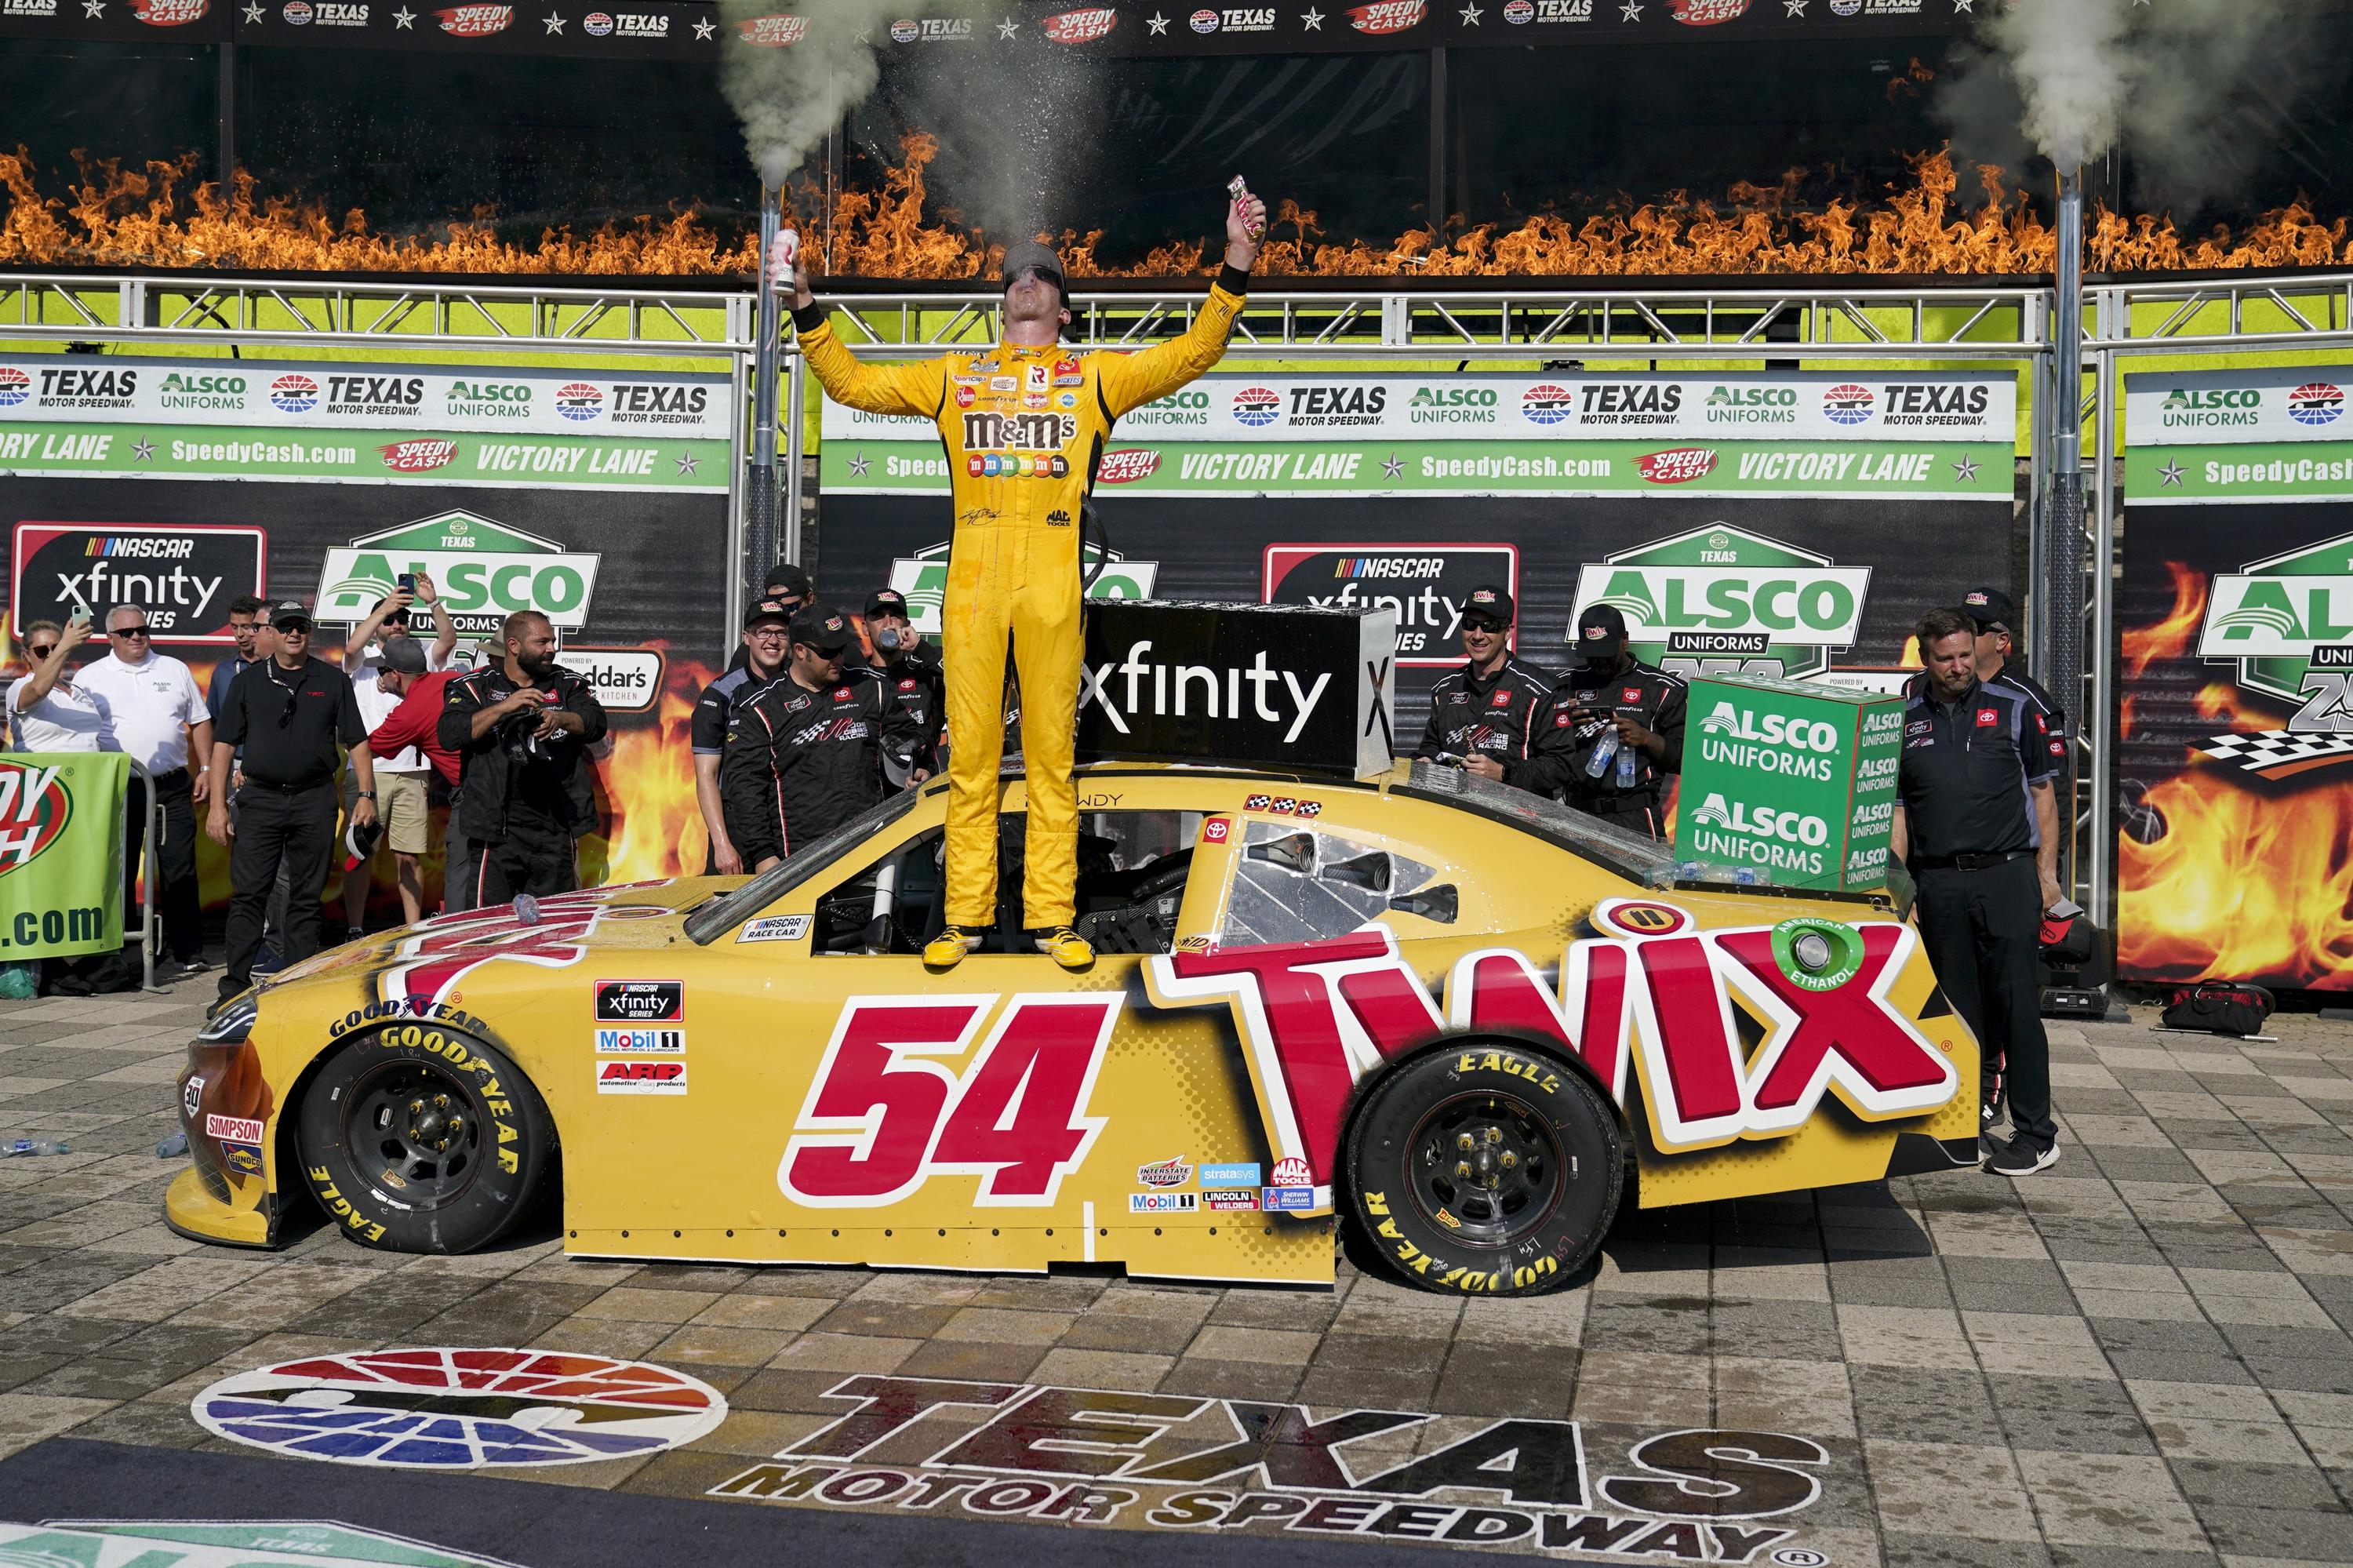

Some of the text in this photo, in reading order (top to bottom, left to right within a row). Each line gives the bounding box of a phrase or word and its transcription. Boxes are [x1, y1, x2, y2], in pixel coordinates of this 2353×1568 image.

[315, 3, 369, 21] TEXAS
[455, 3, 512, 22] SPEEDY
[1060, 8, 1115, 29] SPEEDY
[1221, 9, 1275, 27] TEXAS
[1367, 0, 1424, 20] SPEEDY
[1537, 0, 1592, 17] TEXAS
[616, 14, 669, 32] TEXAS
[922, 18, 973, 35] TEXAS
[40, 370, 137, 397] TEXAS
[159, 373, 246, 394] ALSCO
[328, 377, 424, 405] TEXAS
[445, 381, 532, 402] ALSCO
[39, 398, 135, 409] MOTOR SPEEDWAY
[161, 396, 245, 409] UNIFORMS
[612, 386, 707, 413] TEXAS
[1289, 387, 1387, 414] TEXAS
[1408, 387, 1497, 407] ALSCO
[1582, 384, 1682, 413] TEXAS
[1704, 386, 1797, 406] ALSCO
[1884, 384, 1989, 413] TEXAS
[2160, 388, 2260, 409] ALSCO
[327, 404, 422, 417] MOTOR SPEEDWAY
[448, 403, 530, 418] UNIFORMS
[612, 413, 705, 424] MOTOR SPEEDWAY
[1126, 412, 1208, 425] UNIFORMS
[1411, 409, 1496, 424] UNIFORMS
[1580, 414, 1679, 425] MOTOR SPEEDWAY
[1707, 409, 1795, 423] UNIFORMS
[1883, 415, 1987, 426] MOTOR SPEEDWAY
[2163, 412, 2258, 427] UNIFORMS
[1289, 416, 1385, 426] MOTOR SPEEDWAY
[42, 434, 113, 460] LANE
[172, 439, 356, 464] SpeedyCash.com
[397, 441, 456, 457] SPEEDY
[477, 444, 658, 475] VICTORY LANE
[1104, 450, 1159, 469] SPEEDY
[1180, 453, 1363, 480] VICTORY LANE
[1421, 456, 1610, 478] SpeedyCash.com
[1654, 449, 1717, 468] SPEEDY
[1738, 453, 1934, 481] VICTORY LANE
[1046, 509, 1071, 522] MAC
[111, 537, 194, 558] NASCAR
[441, 536, 475, 548] TEXAS
[1700, 550, 1737, 562] TEXAS
[1361, 558, 1444, 578] NASCAR
[56, 561, 223, 618] xfinity
[1581, 570, 1854, 631] ALSCO
[416, 613, 500, 631] UNORMS
[1675, 635, 1763, 651] UNIFORMS
[601, 690, 638, 700] KITCHEN
[1077, 640, 1332, 744] xfinity
[844, 726, 867, 736] GIBBS
[1698, 701, 1838, 753] ALSCO
[1863, 711, 1902, 732] ALSCO
[839, 732, 868, 741] RACING
[1862, 731, 1900, 748] UNIFORMS
[1702, 739, 1831, 781] UNIFORMS
[1857, 757, 1897, 778] ALSCO
[1857, 776, 1894, 793] UNIFORMS
[1690, 792, 1828, 846] ALSCO
[1852, 802, 1892, 824] ALSCO
[1852, 820, 1889, 839] UNIFORMS
[1694, 829, 1823, 875] UNIFORMS
[1847, 846, 1887, 870] ALSCO
[1847, 865, 1885, 884] UNIFORMS
[2, 906, 103, 947] .com
[747, 930, 773, 938] RACE
[763, 919, 802, 929] NASCAR
[1777, 917, 1846, 934] AMERICAN
[1790, 967, 1856, 990] ETHANOL
[609, 992, 669, 1014] xfinity
[329, 994, 489, 1038] GOODYEAR
[600, 1031, 655, 1048] Mobil
[600, 1063, 683, 1080] ARP
[1459, 1054, 1560, 1094] EAGLE
[186, 1084, 200, 1108] 30
[380, 1026, 519, 1175] GOODYEAR
[776, 991, 1127, 1209] 54
[209, 1116, 260, 1141] SIMPSON
[230, 1154, 260, 1167] SUNOCO
[1274, 1159, 1309, 1177] MAC
[1204, 1169, 1255, 1180] stratasys
[309, 1166, 387, 1242] EAGLE
[1133, 1195, 1176, 1208] Mobil
[1205, 1191, 1249, 1201] LINCOLN
[1215, 1201, 1254, 1210] WELDERS
[1365, 1191, 1558, 1293] GOODYEAR
[773, 1373, 1829, 1520] TEXAS
[706, 1464, 1798, 1566] MOTOR SPEEDWAY
